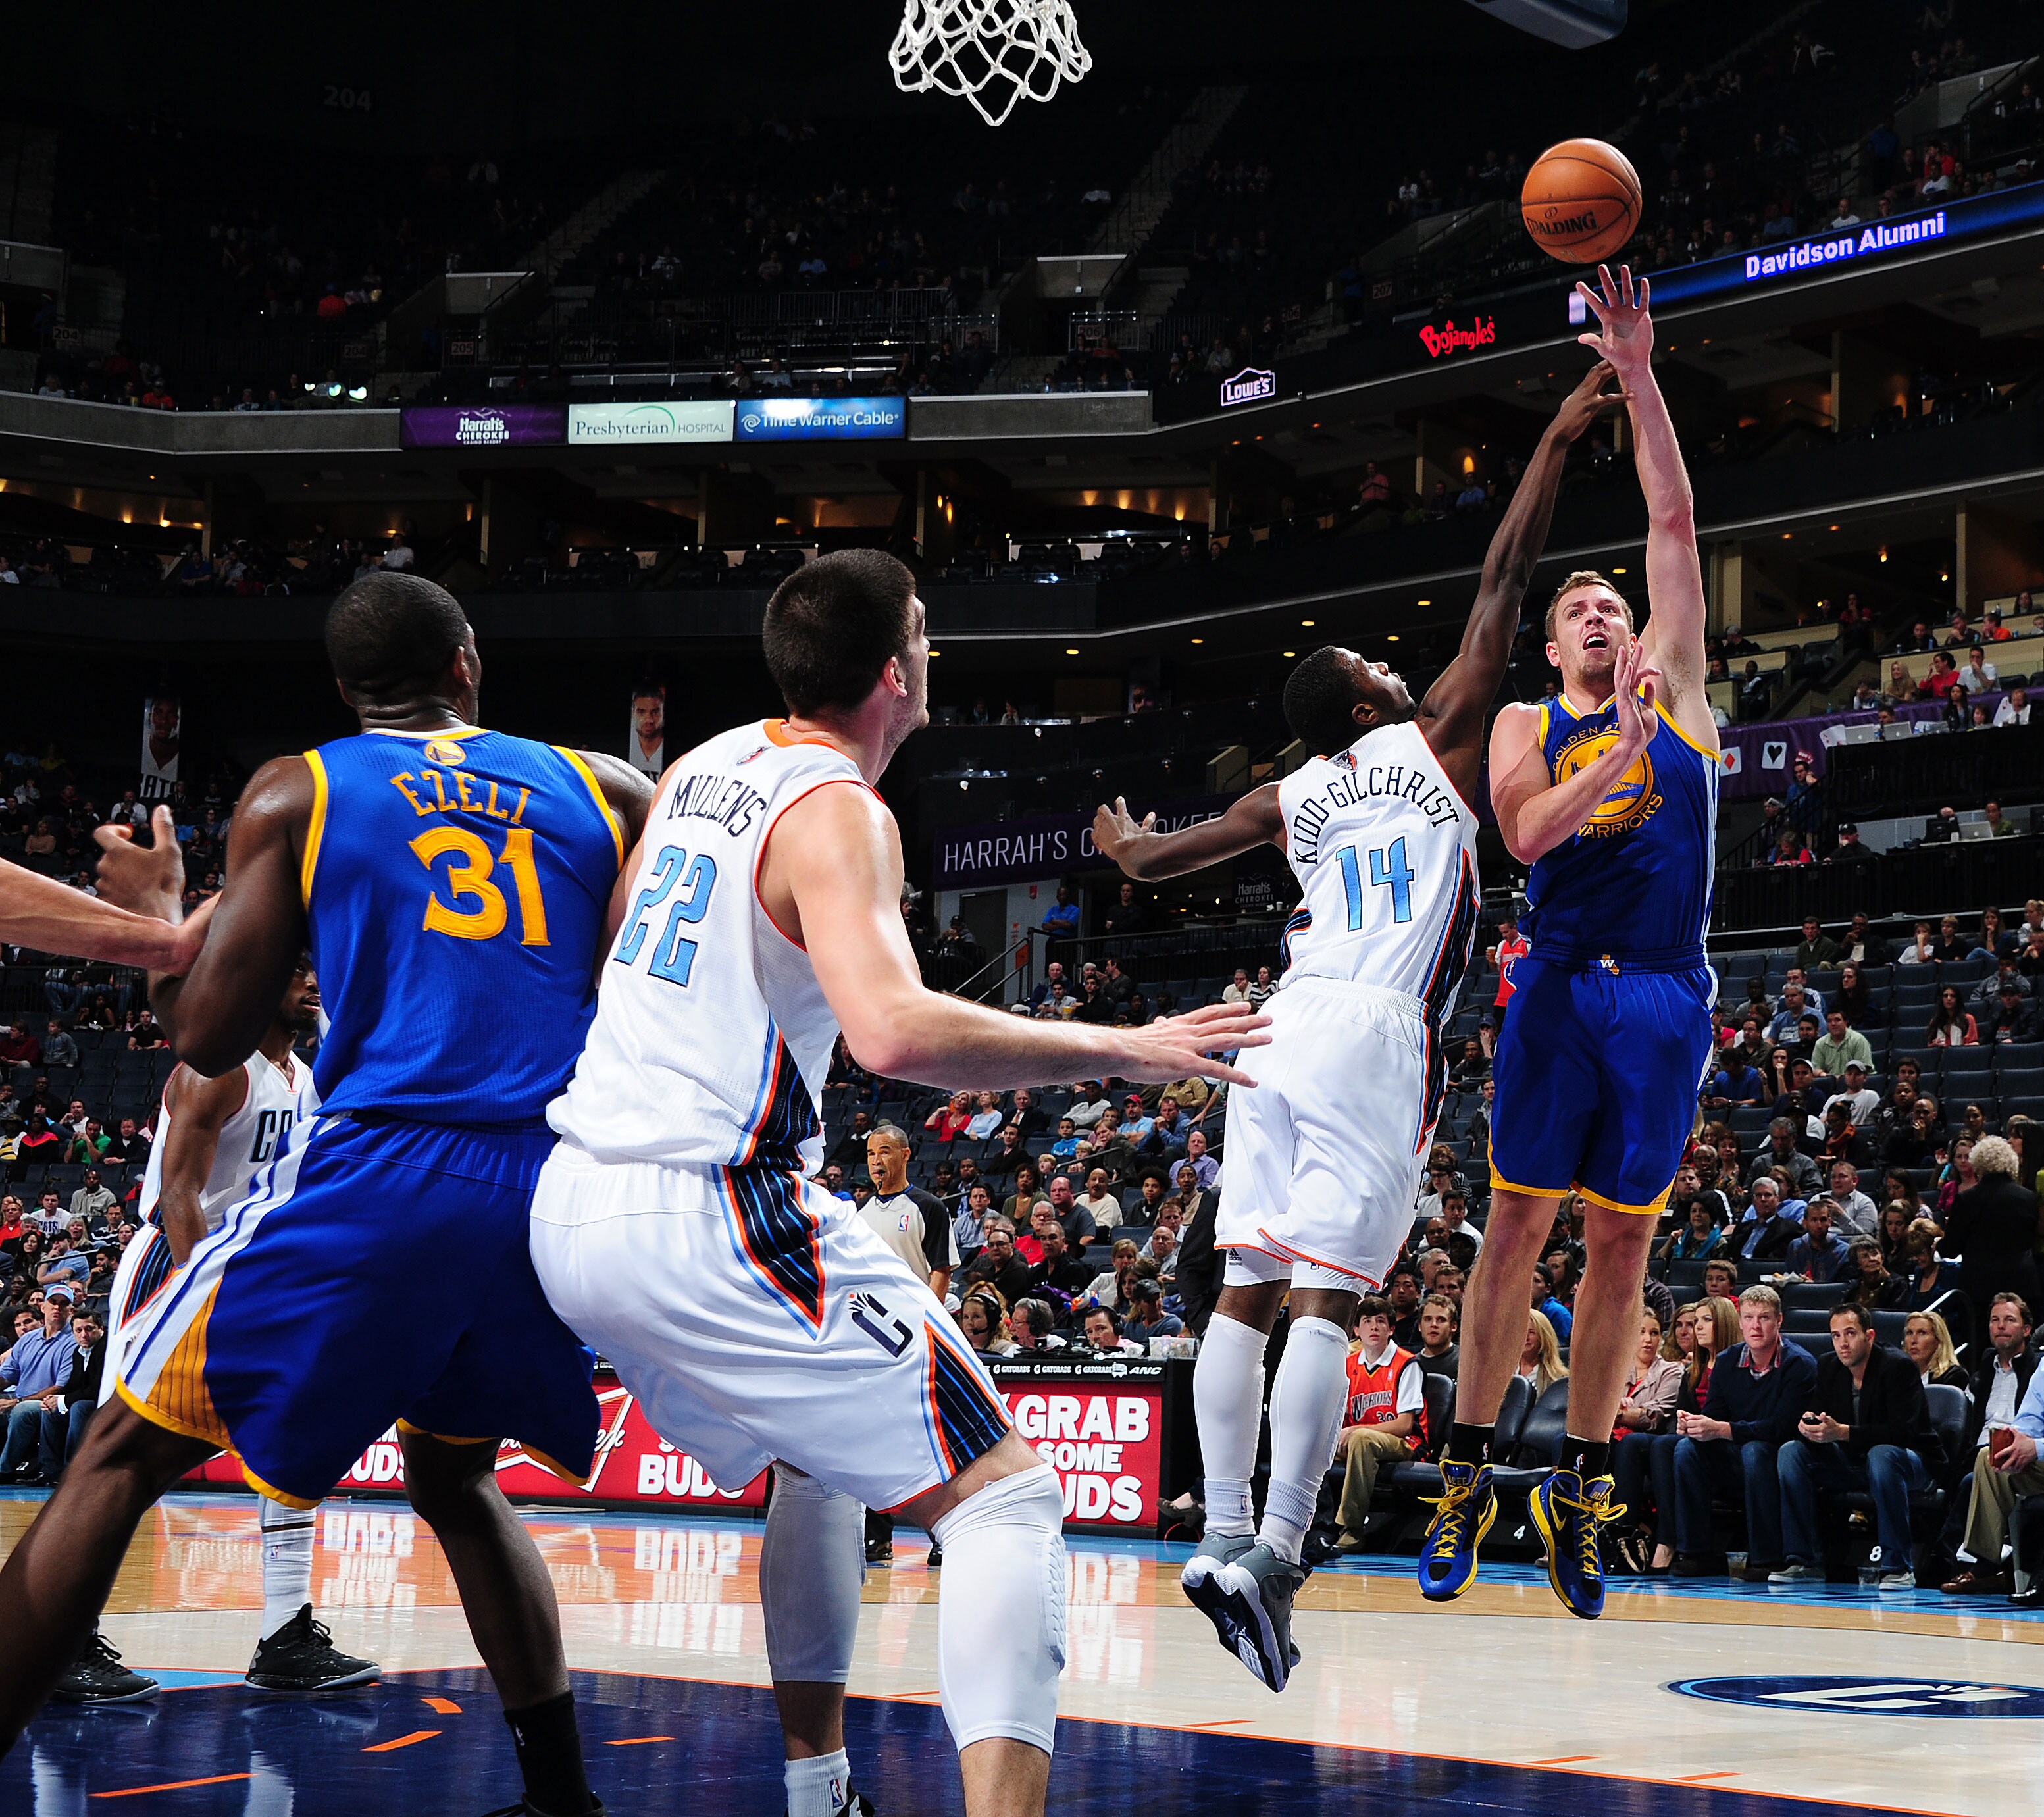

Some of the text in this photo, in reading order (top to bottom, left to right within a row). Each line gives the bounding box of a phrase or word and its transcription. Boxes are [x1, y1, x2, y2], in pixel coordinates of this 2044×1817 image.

[322, 84, 373, 112] 204
[1526, 211, 1597, 235] SPALDING
[1745, 212, 1946, 279] Davidson Alumni
[54, 328, 77, 339] 204
[452, 344, 473, 353] 205
[1226, 377, 1271, 401] LOWE'S
[455, 430, 509, 441] CHEROKEE
[460, 418, 504, 432] Harrah's
[576, 420, 726, 438] Presbyterian HOSPITAL
[761, 414, 796, 427] Time
[800, 413, 851, 427] Warner
[390, 769, 532, 824] EZELI
[667, 774, 767, 838] MULLENS
[1294, 766, 1460, 865] KIDD-GILCHRIST
[944, 830, 1067, 873] HARRAH'S
[408, 826, 551, 946] 31
[1335, 836, 1414, 932] 14
[613, 844, 717, 988] 22
[1129, 1366, 1162, 1375] ANC
[1015, 1395, 1150, 1443] GRAB
[341, 1444, 405, 1482] UD
[1036, 1441, 1123, 1473] SOME
[637, 1454, 745, 1499] BUD
[1058, 1474, 1143, 1522] UDS
[1514, 1525, 1526, 1539] 4
[1868, 1545, 1882, 1562] 8
